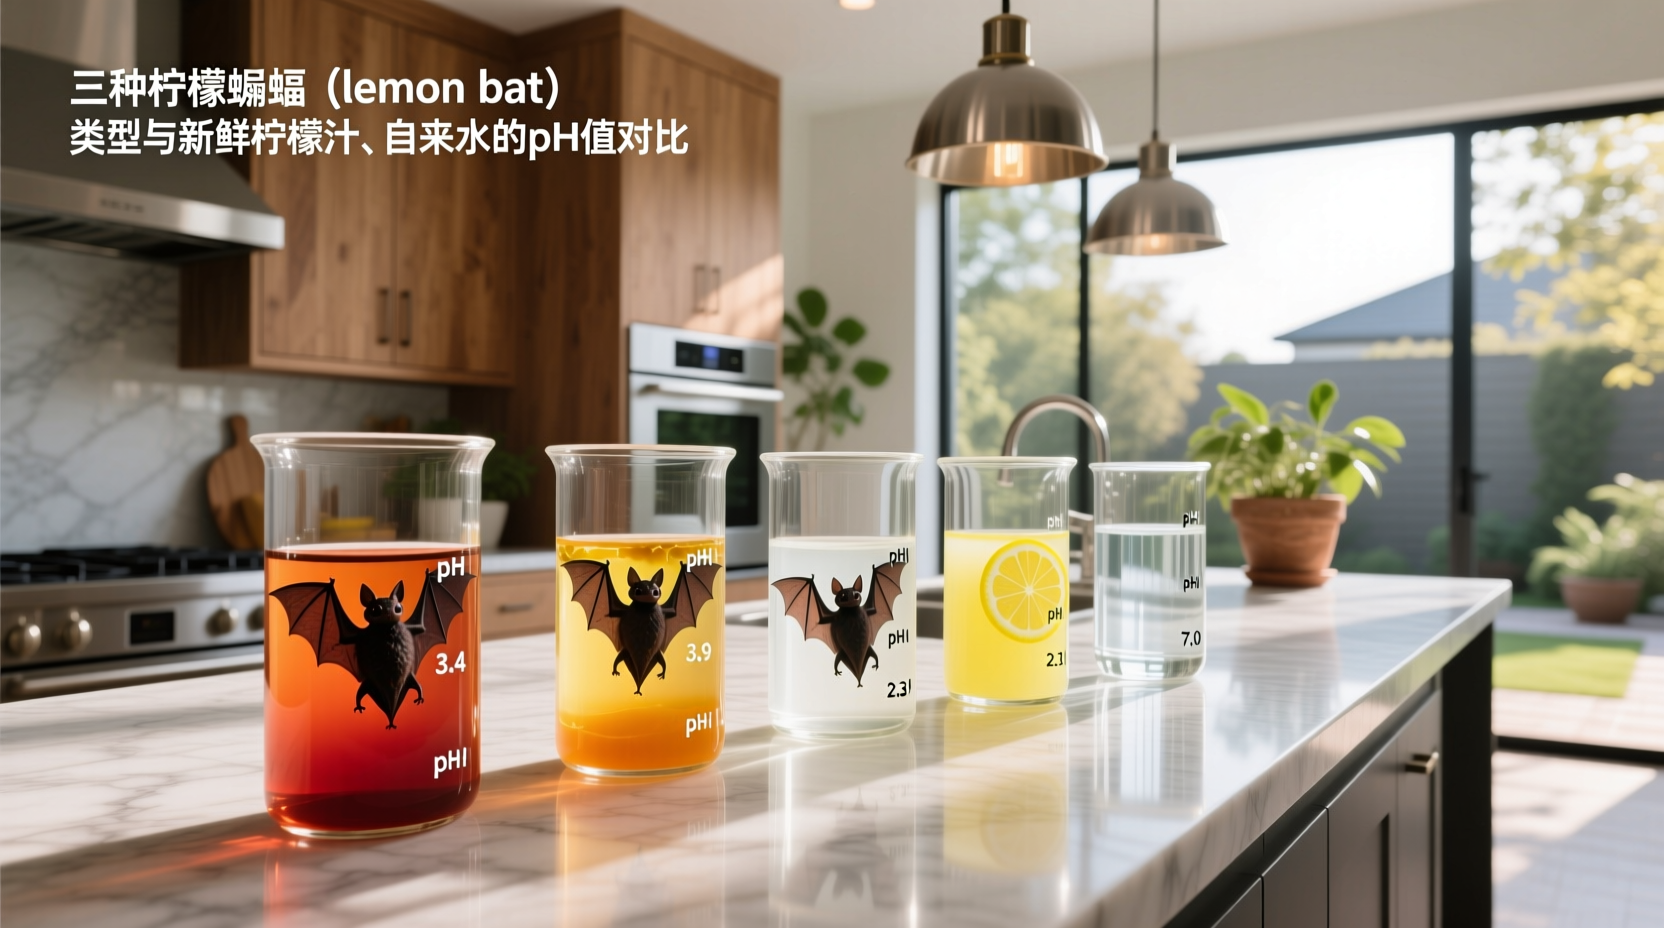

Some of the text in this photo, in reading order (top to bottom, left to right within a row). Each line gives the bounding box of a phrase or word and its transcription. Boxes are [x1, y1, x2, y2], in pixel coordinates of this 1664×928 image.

[437, 556, 465, 583] pH
[1181, 630, 1202, 647] 7.0
[435, 651, 466, 675] 3.4
[686, 642, 712, 662] 3.9
